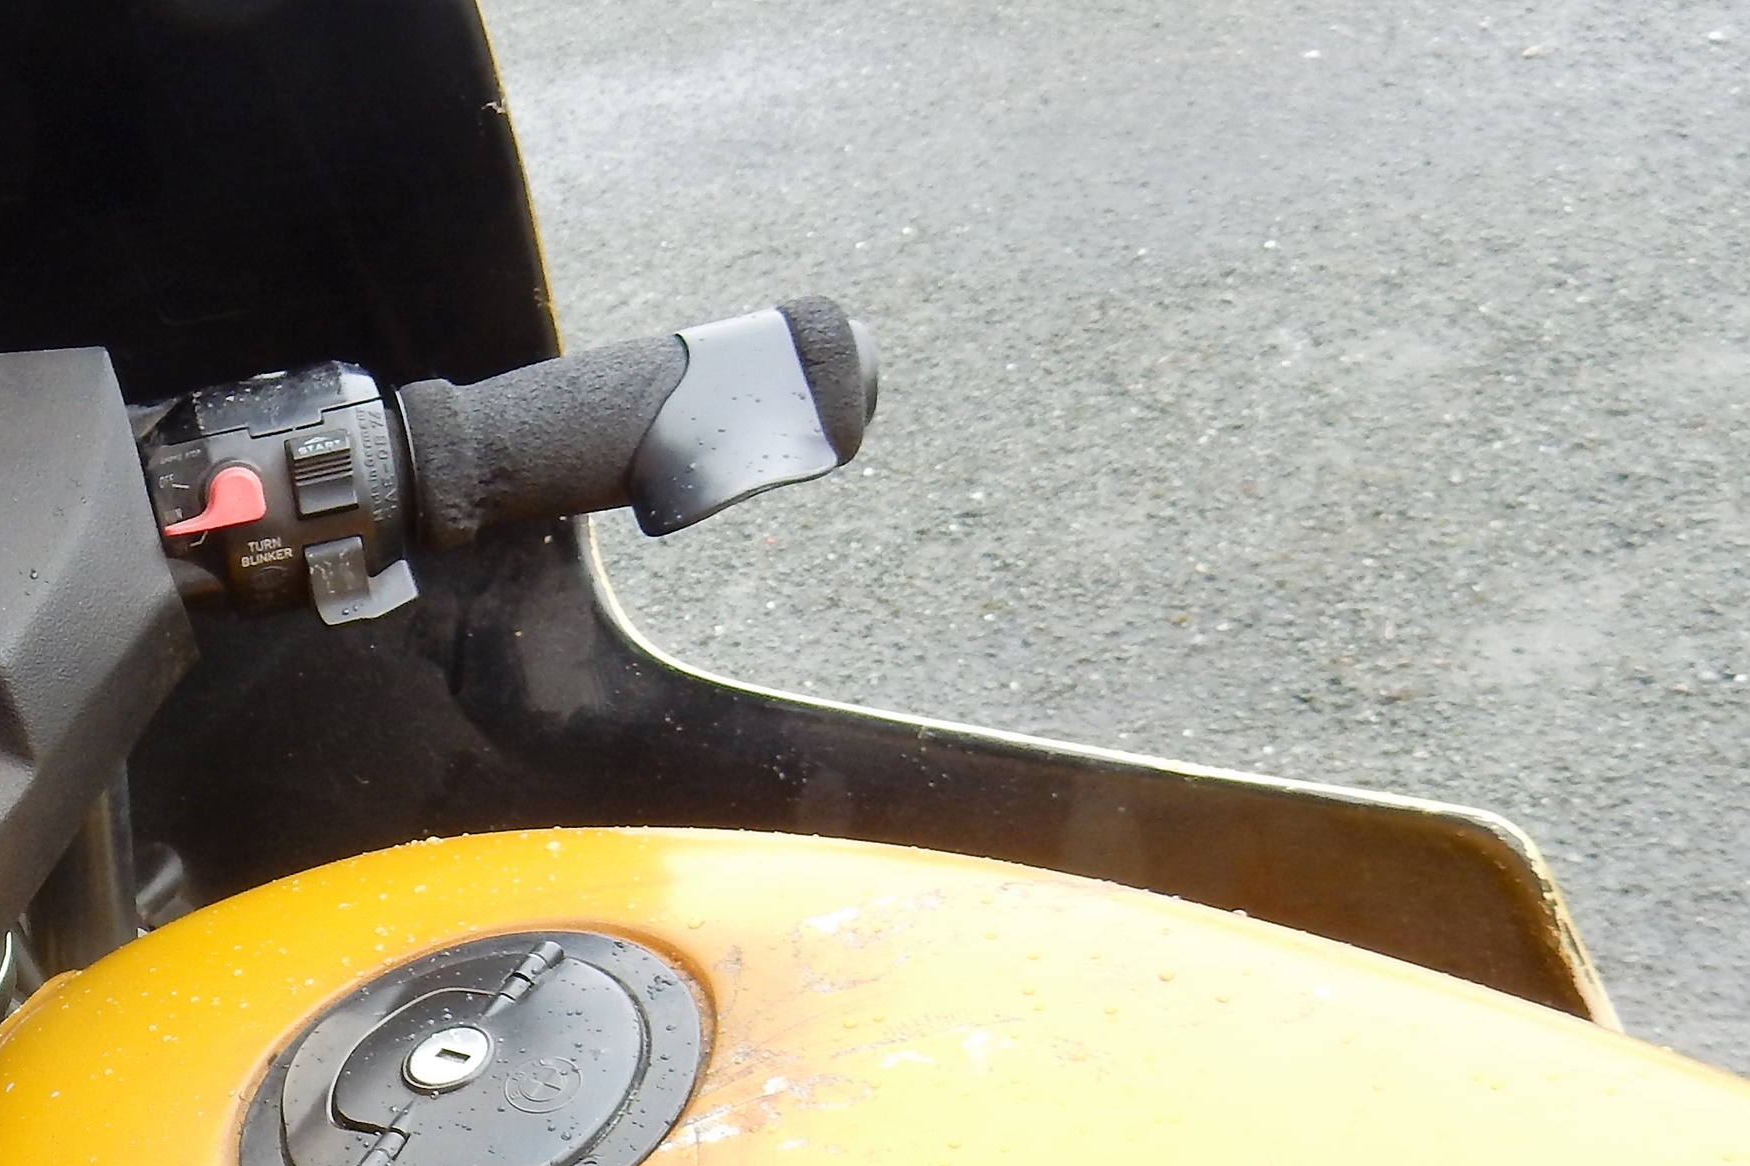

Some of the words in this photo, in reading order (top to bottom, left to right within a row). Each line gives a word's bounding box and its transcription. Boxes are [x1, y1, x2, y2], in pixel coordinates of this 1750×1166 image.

[298, 439, 342, 456] START
[247, 536, 283, 553] TURN
[241, 547, 293, 568] BLINKER
